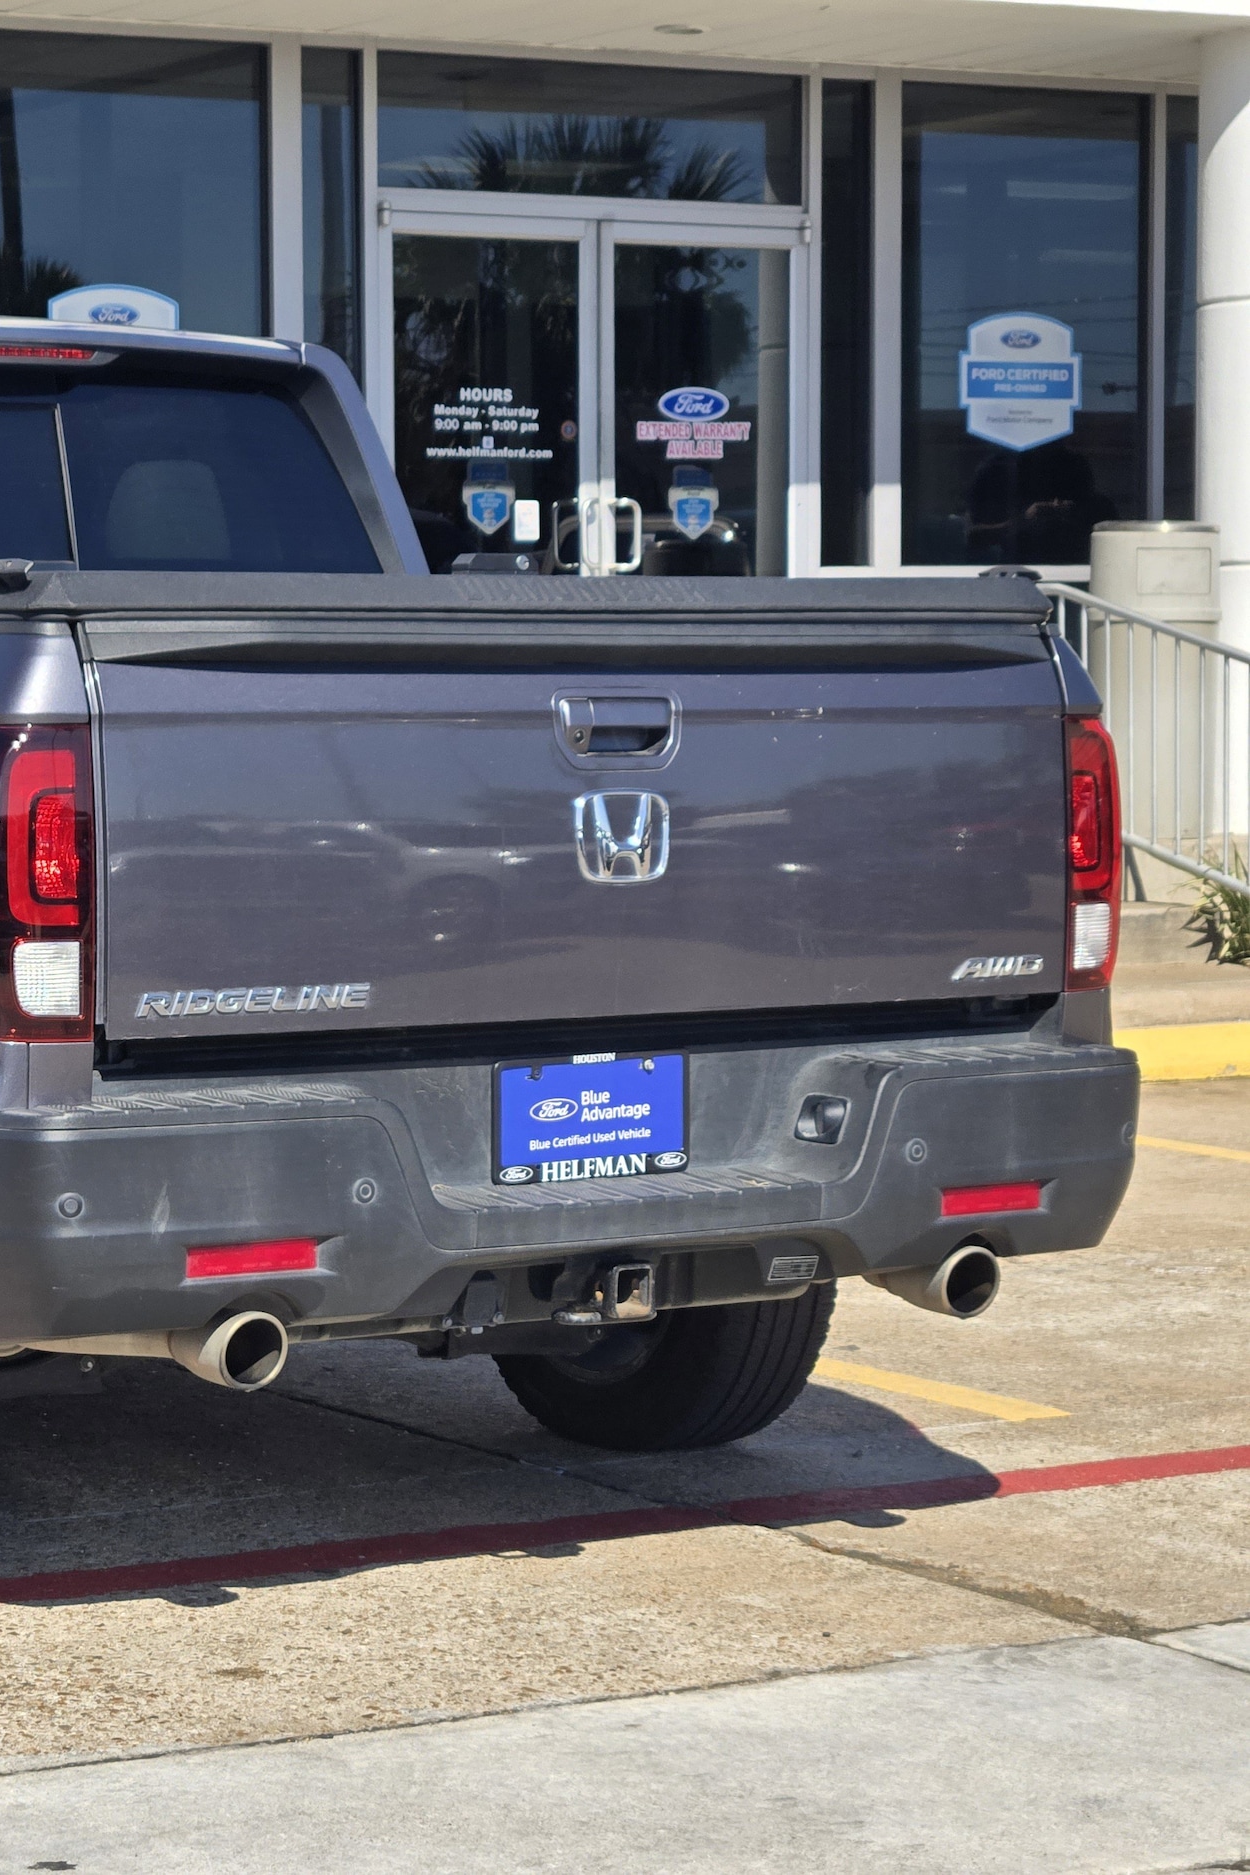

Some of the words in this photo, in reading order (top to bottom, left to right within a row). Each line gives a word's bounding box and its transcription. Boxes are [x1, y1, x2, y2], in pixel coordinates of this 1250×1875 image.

[98, 307, 129, 322] Ford
[971, 367, 1006, 380] FORD
[1007, 368, 1069, 381] CERTIFIED
[459, 387, 513, 402] HOURS
[994, 383, 1047, 393] PRE-OWNED
[674, 393, 715, 414] Ford
[434, 404, 479, 418] Monday
[487, 405, 540, 420] Saturday
[434, 418, 460, 431] 9:00
[463, 421, 482, 431] am
[492, 420, 518, 432] 9:00
[520, 422, 540, 434] pm
[637, 421, 692, 440] EXTENDED
[693, 422, 751, 441] WARRANTY
[426, 446, 553, 459] www.helfmanford.com
[666, 440, 724, 459] AVAILABLE
[951, 954, 1044, 981] AWD
[135, 982, 371, 1019] RIDGELINE
[573, 1052, 616, 1064] HOUSTON
[581, 1090, 610, 1105] Blue
[538, 1101, 569, 1118] Ford
[581, 1102, 650, 1122] Advantage
[529, 1139, 551, 1151] Blue
[553, 1135, 591, 1149] Certified
[594, 1132, 616, 1144] Used
[618, 1127, 651, 1140] Vehicle
[541, 1153, 648, 1182] HELFMAN
